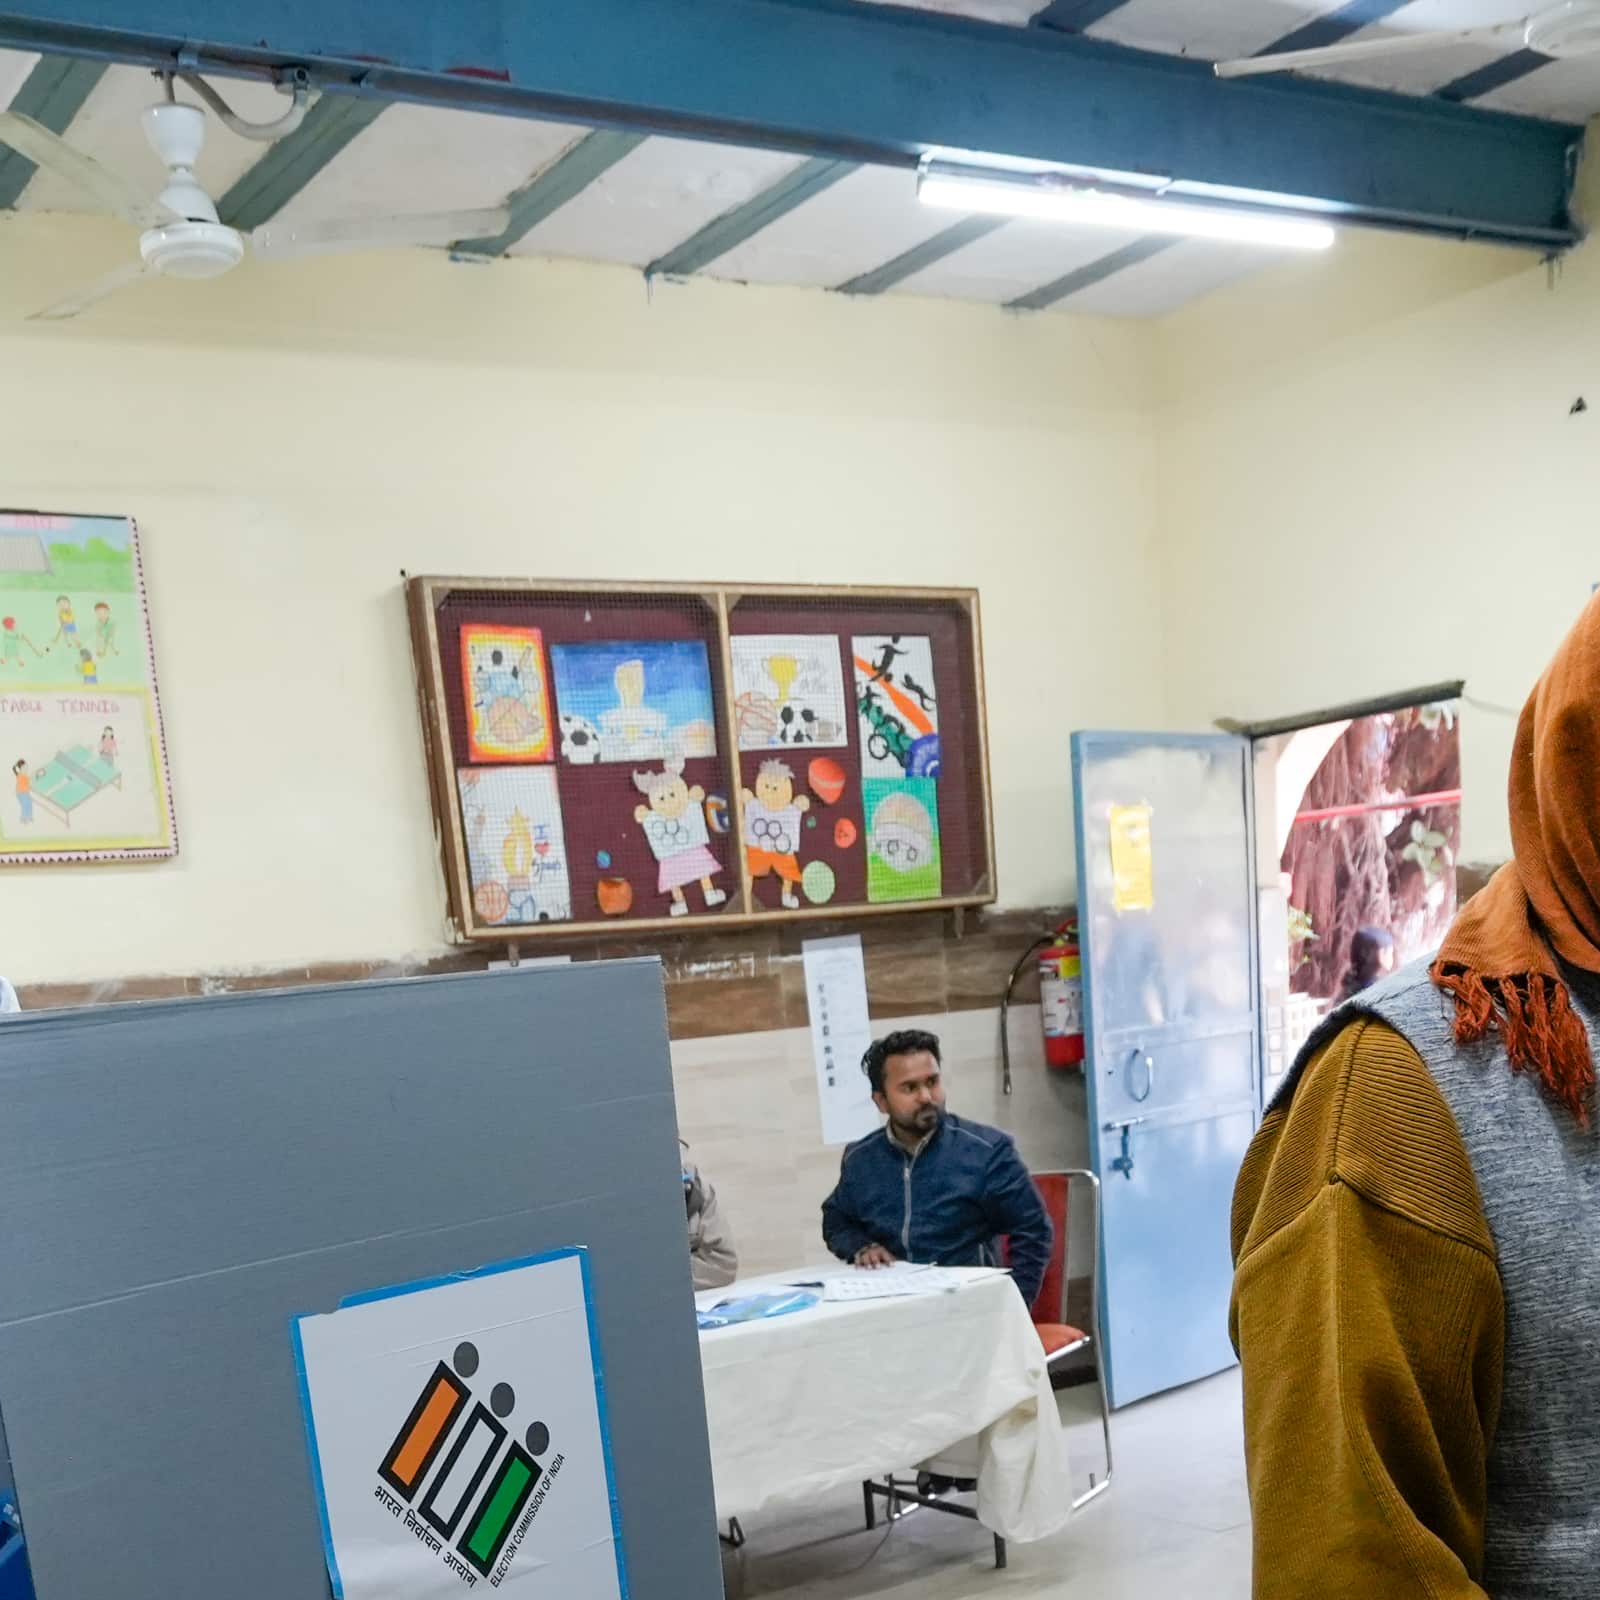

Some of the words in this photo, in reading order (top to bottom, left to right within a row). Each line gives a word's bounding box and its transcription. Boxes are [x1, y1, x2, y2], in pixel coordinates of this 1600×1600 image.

[373, 1485, 404, 1519] भारत
[402, 1508, 444, 1556] निर्वाचन
[442, 1552, 478, 1588] आयोग
[490, 1542, 519, 1588] ELECTION
[512, 1489, 547, 1545] COMMISSION
[541, 1477, 554, 1491] OF
[549, 1453, 566, 1480] INDIA
